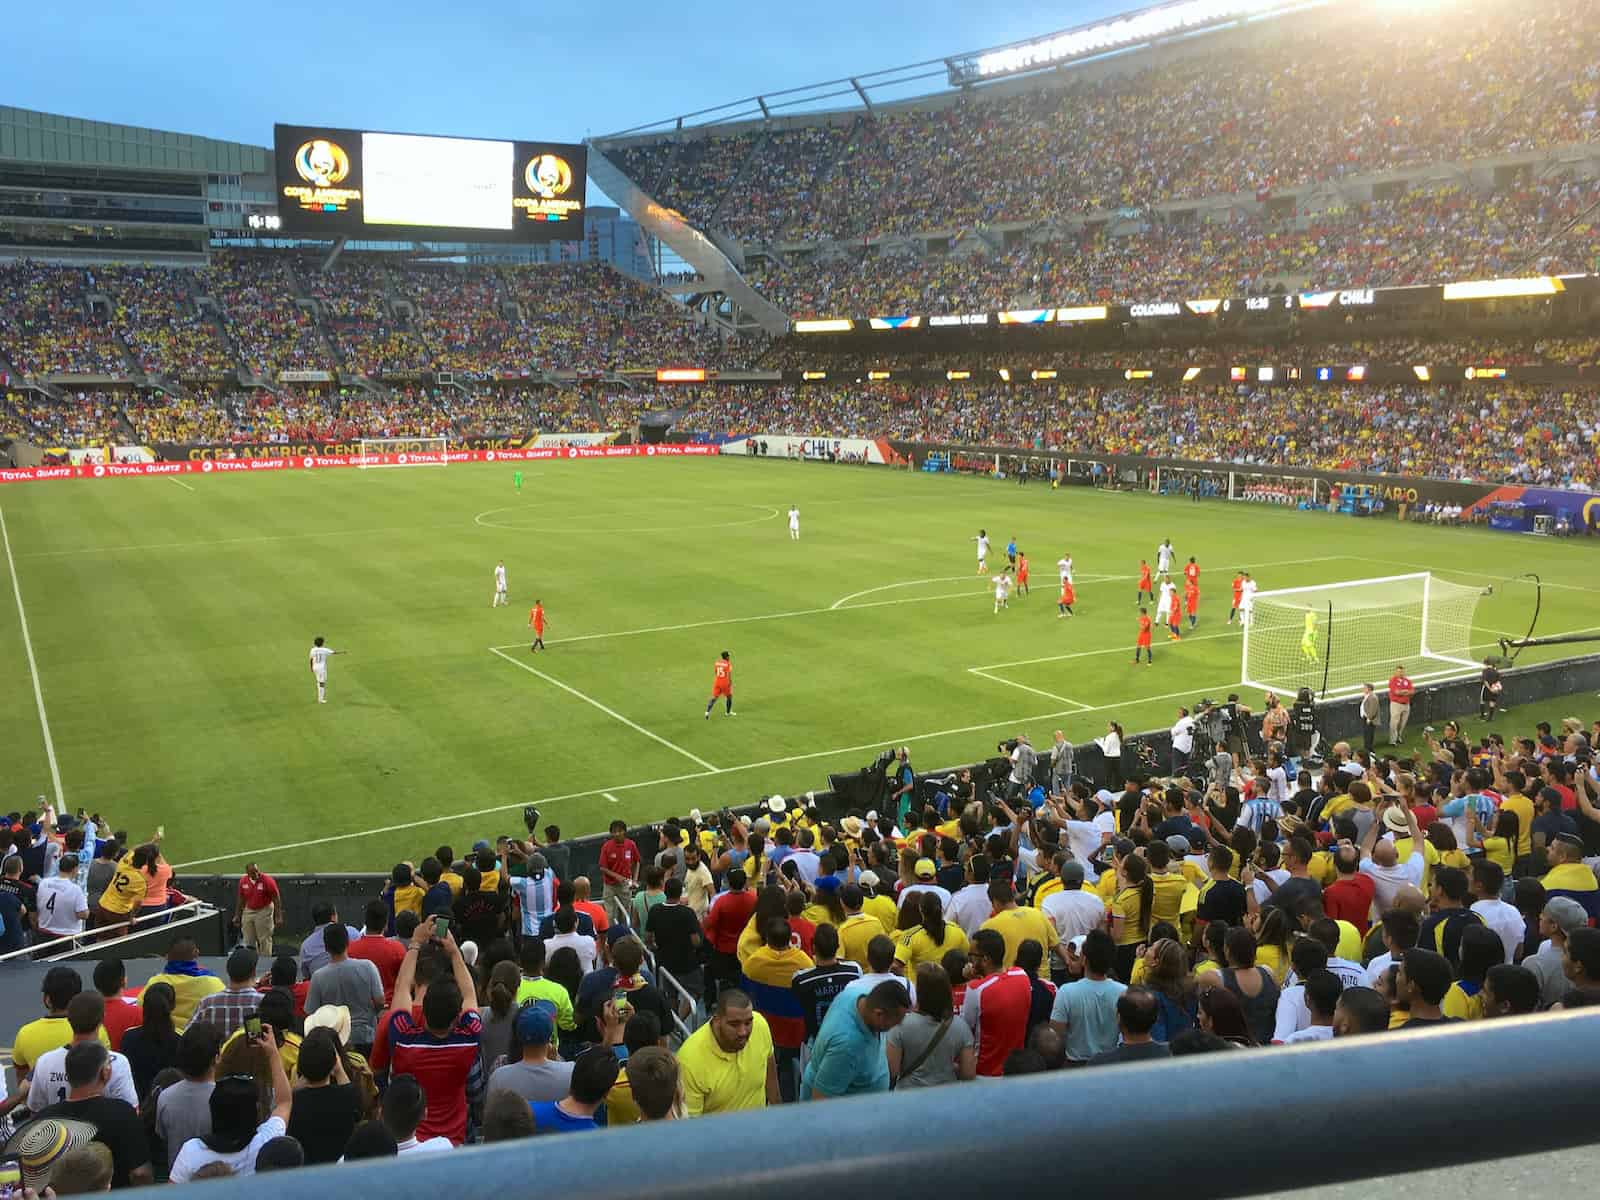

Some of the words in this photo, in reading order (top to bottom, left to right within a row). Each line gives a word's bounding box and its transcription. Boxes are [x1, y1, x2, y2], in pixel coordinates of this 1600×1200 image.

[1130, 302, 1180, 317] COLOMBIA
[1284, 295, 1292, 308] 2
[1338, 288, 1374, 305] CHILE
[243, 445, 318, 458] AMRICA
[323, 440, 422, 455] CENTENRIO
[108, 465, 142, 475] TOTAL
[146, 464, 180, 473] QUARTZ
[316, 457, 346, 466] TOTAL
[0, 471, 34, 481] TOTAL
[36, 469, 70, 478] QUARTZ
[113, 871, 130, 893] 12
[46, 891, 57, 915] 4
